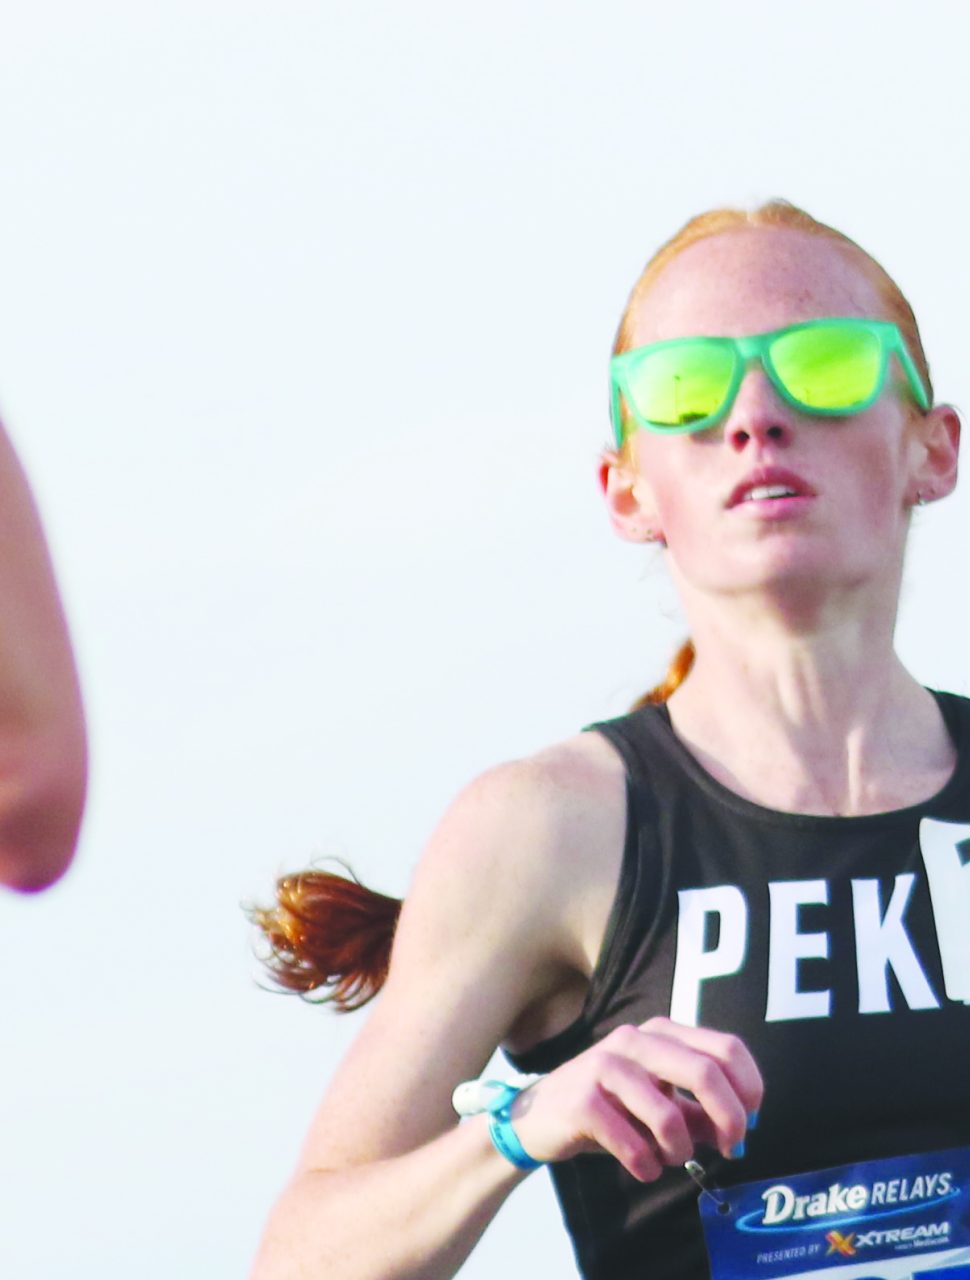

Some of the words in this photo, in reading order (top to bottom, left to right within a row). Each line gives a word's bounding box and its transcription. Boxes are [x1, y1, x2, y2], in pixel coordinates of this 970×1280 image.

[761, 1183, 868, 1226] Drake
[871, 1172, 953, 1206] RELAYS
[756, 1245, 806, 1264] PRESENTED
[807, 1242, 821, 1254] BY
[855, 1221, 950, 1248] XTREAM
